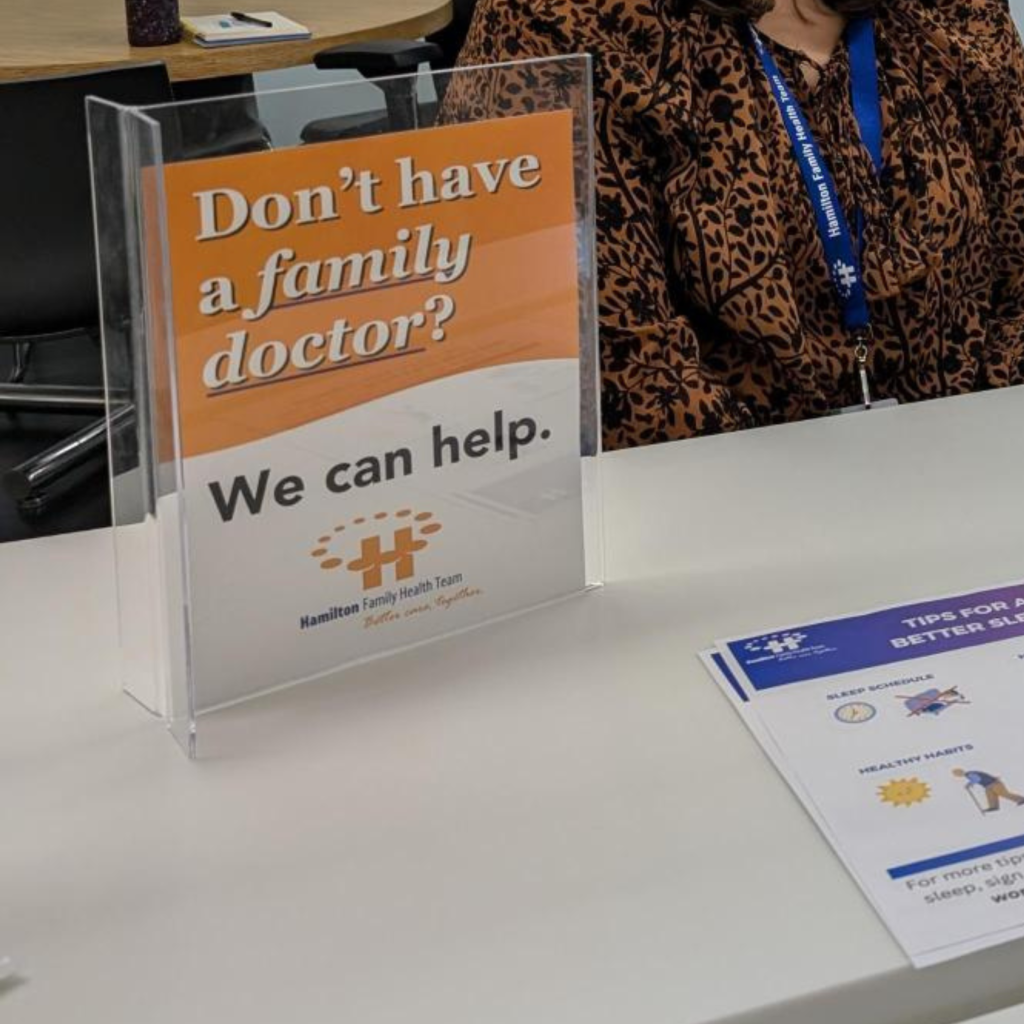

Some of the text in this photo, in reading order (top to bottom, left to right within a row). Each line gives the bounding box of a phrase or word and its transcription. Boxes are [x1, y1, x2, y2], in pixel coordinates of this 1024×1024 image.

[772, 74, 841, 238] Hamilton Family Health Team
[394, 154, 542, 208] have
[198, 223, 472, 321] a family
[202, 294, 456, 390] doctor?
[208, 410, 552, 523] We can help.
[300, 573, 463, 629] Hamilton Family Health Team
[901, 608, 956, 629] TIPS
[958, 601, 1014, 619] FOR
[889, 621, 987, 649] BETTER
[826, 673, 936, 701] SLEEP SCHEDULE
[858, 743, 974, 775] HEALTHY HABITS
[905, 876, 938, 891] For
[942, 862, 993, 879] more
[924, 882, 984, 905] sleep,
[985, 869, 1024, 887] sign
